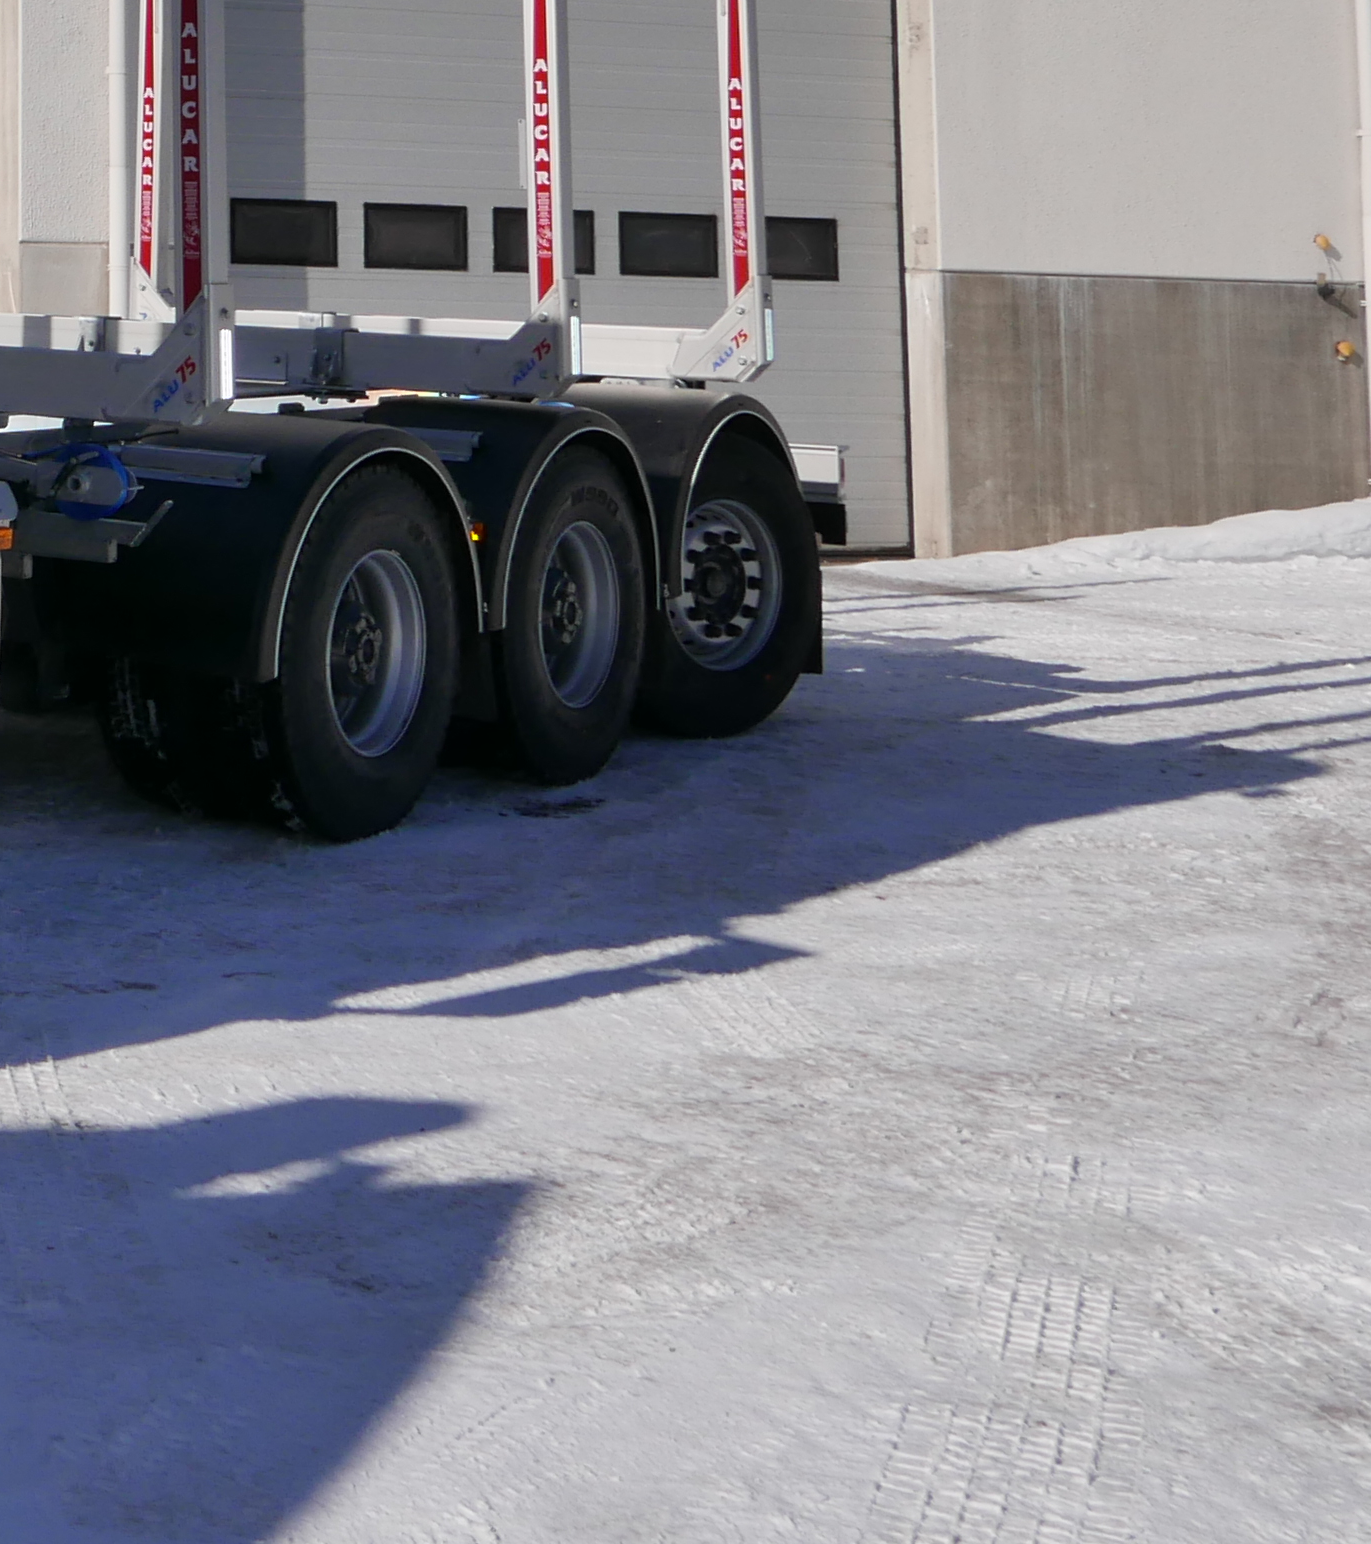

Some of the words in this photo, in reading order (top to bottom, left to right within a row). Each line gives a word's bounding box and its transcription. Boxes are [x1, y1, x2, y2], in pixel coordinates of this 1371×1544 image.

[141, 87, 155, 186] ALUCAR
[181, 22, 200, 172] ALUCAR
[532, 58, 552, 185] ALUCAR
[728, 77, 747, 191] ALUCAR
